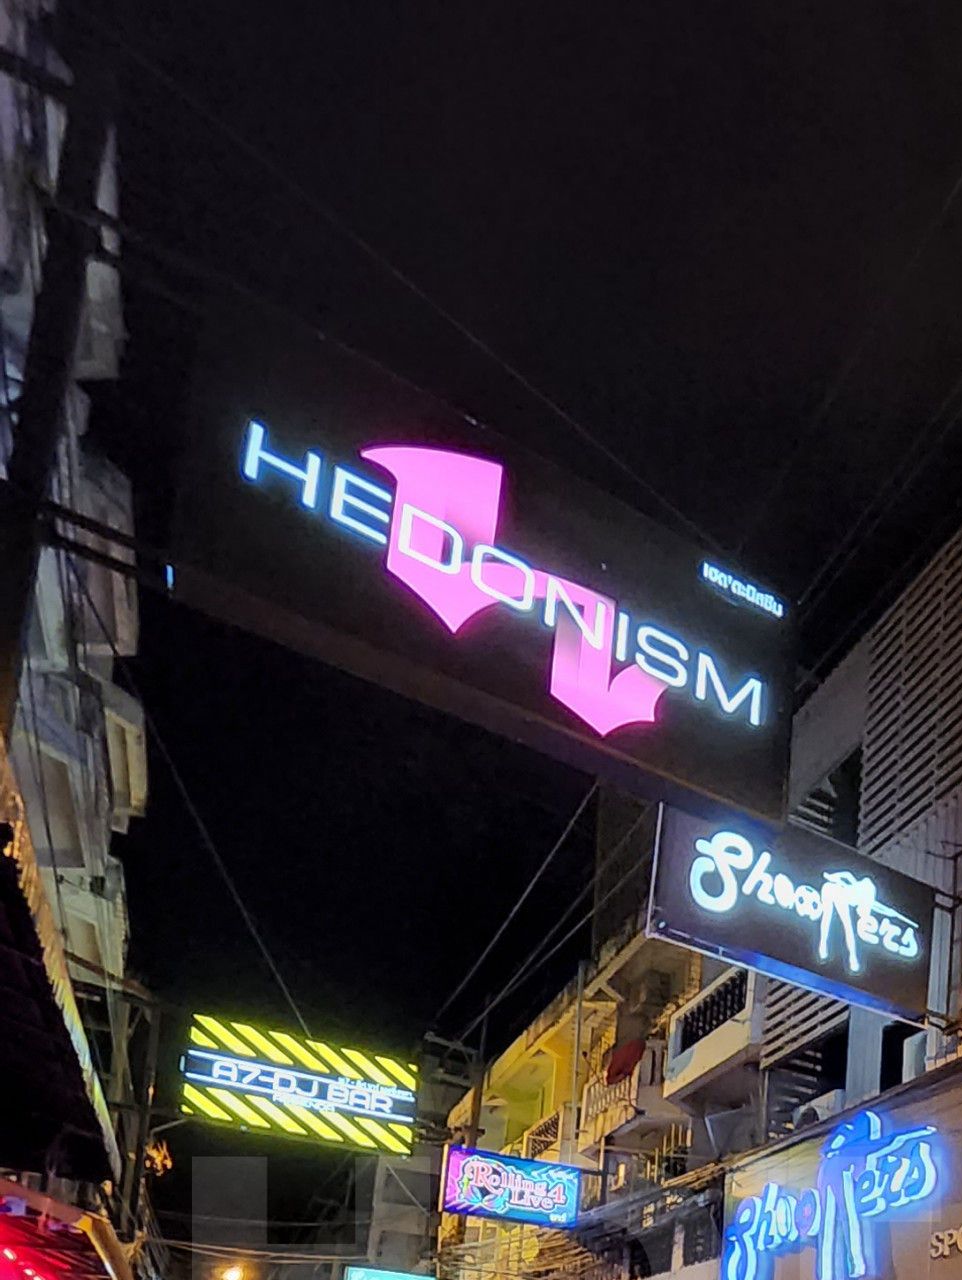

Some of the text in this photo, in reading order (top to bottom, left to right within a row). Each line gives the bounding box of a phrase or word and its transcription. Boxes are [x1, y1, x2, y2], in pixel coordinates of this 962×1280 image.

[243, 420, 763, 727] HEDONISM
[327, 1082, 394, 1114] BAR
[464, 1160, 548, 1197] Rolling
[511, 1189, 554, 1211] Live
